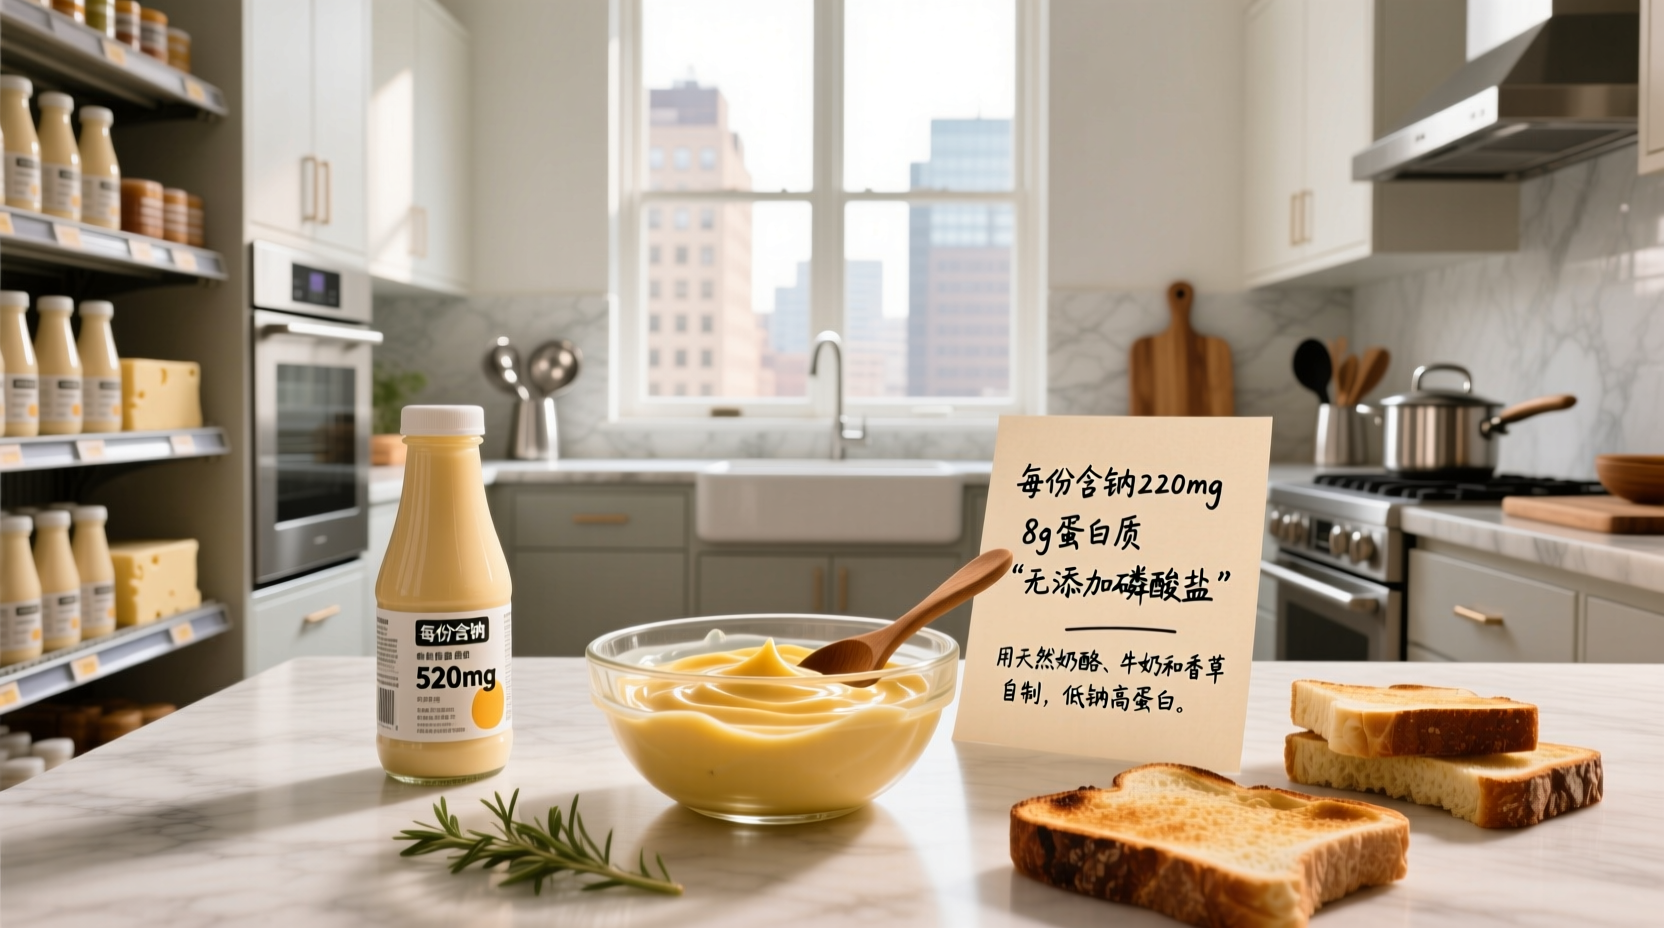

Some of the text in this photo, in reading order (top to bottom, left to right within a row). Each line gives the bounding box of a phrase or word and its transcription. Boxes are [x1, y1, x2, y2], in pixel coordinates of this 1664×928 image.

[1017, 464, 1223, 510] 每份含钠220mg
[1022, 514, 1140, 555] 8g蛋白质
[420, 621, 486, 643] 每份含钠
[416, 665, 496, 692] 520mg
[996, 646, 1225, 684] 用天然奶酪、牛奶和香草
